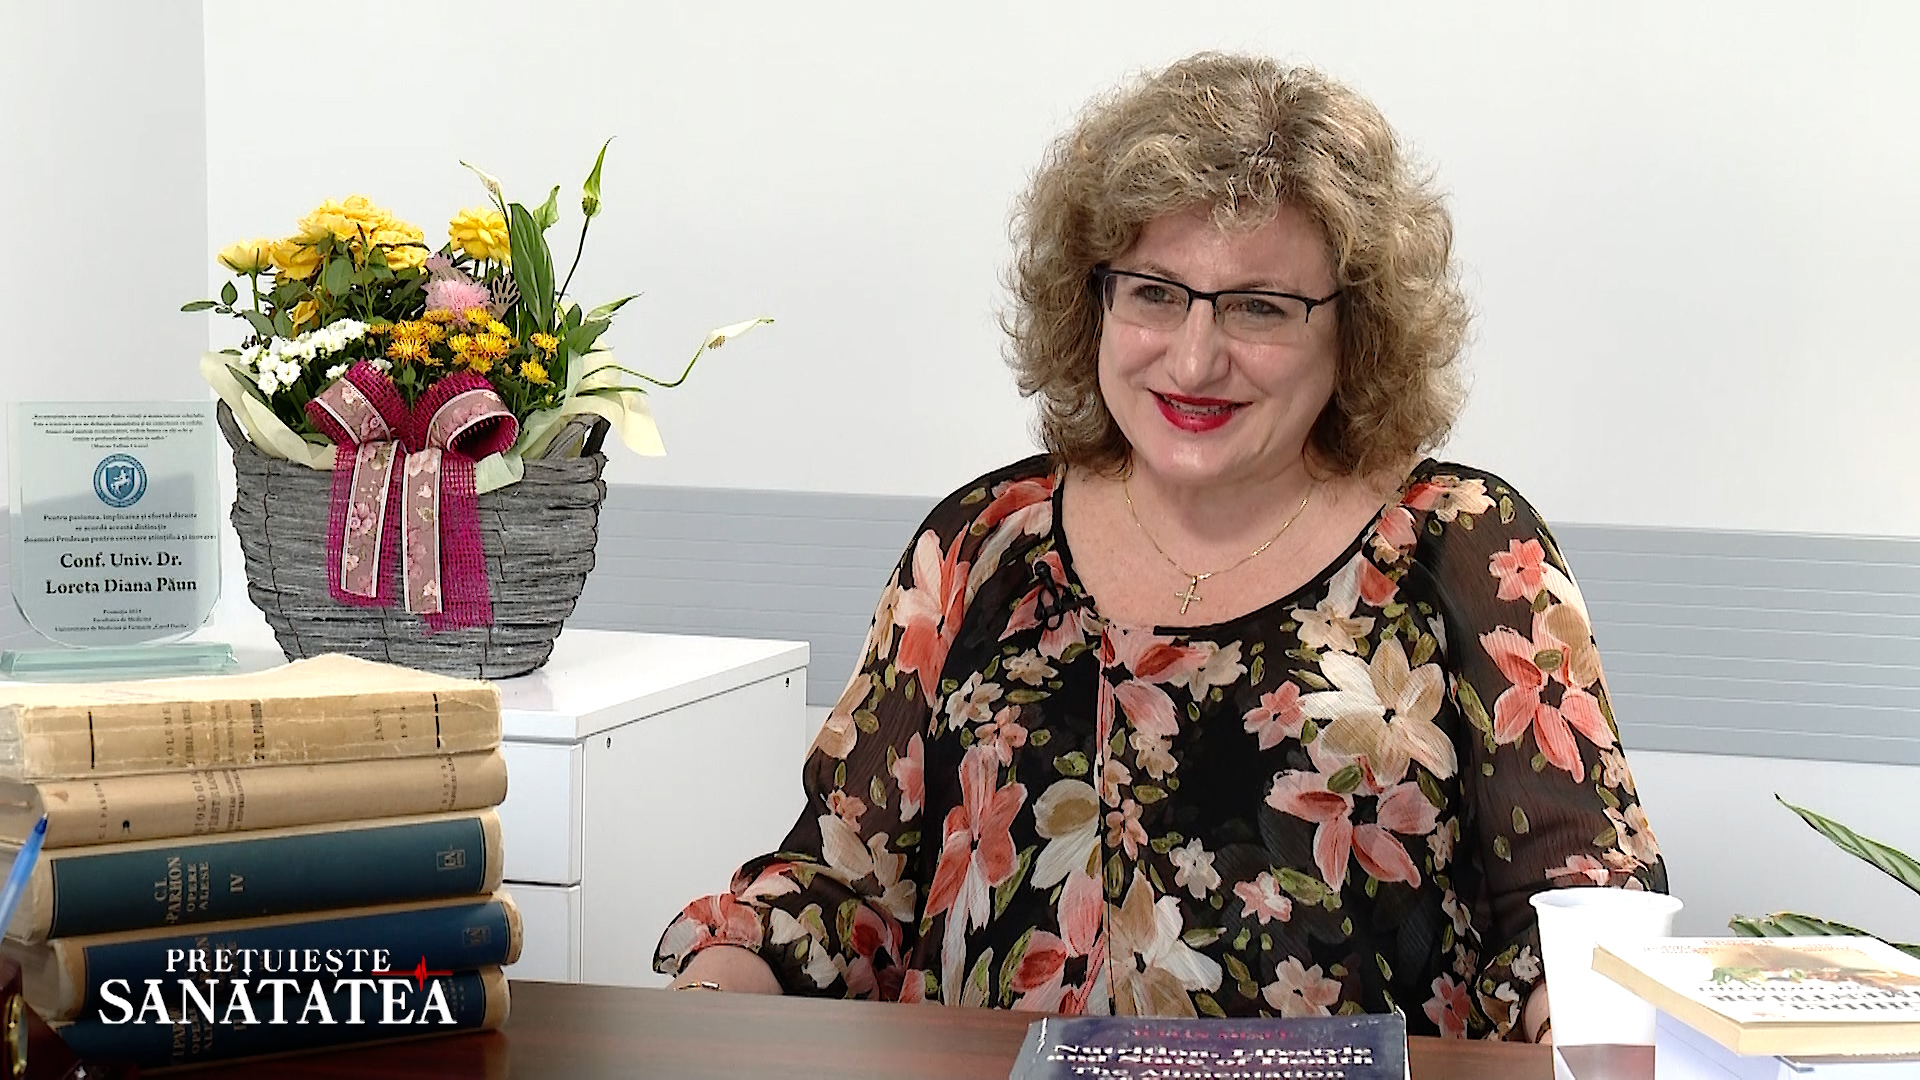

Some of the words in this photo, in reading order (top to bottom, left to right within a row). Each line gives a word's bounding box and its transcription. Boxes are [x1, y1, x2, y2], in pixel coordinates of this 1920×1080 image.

[60, 552, 106, 568] Conf.
[110, 553, 152, 567] Univ.
[157, 551, 183, 567] Dr.
[46, 579, 100, 595] Loreta
[104, 578, 152, 593] Diana
[156, 577, 197, 593] Păun
[166, 857, 182, 922] PARHON
[187, 863, 198, 912] OPERE
[198, 862, 209, 910] ALESE
[229, 873, 244, 893] IV
